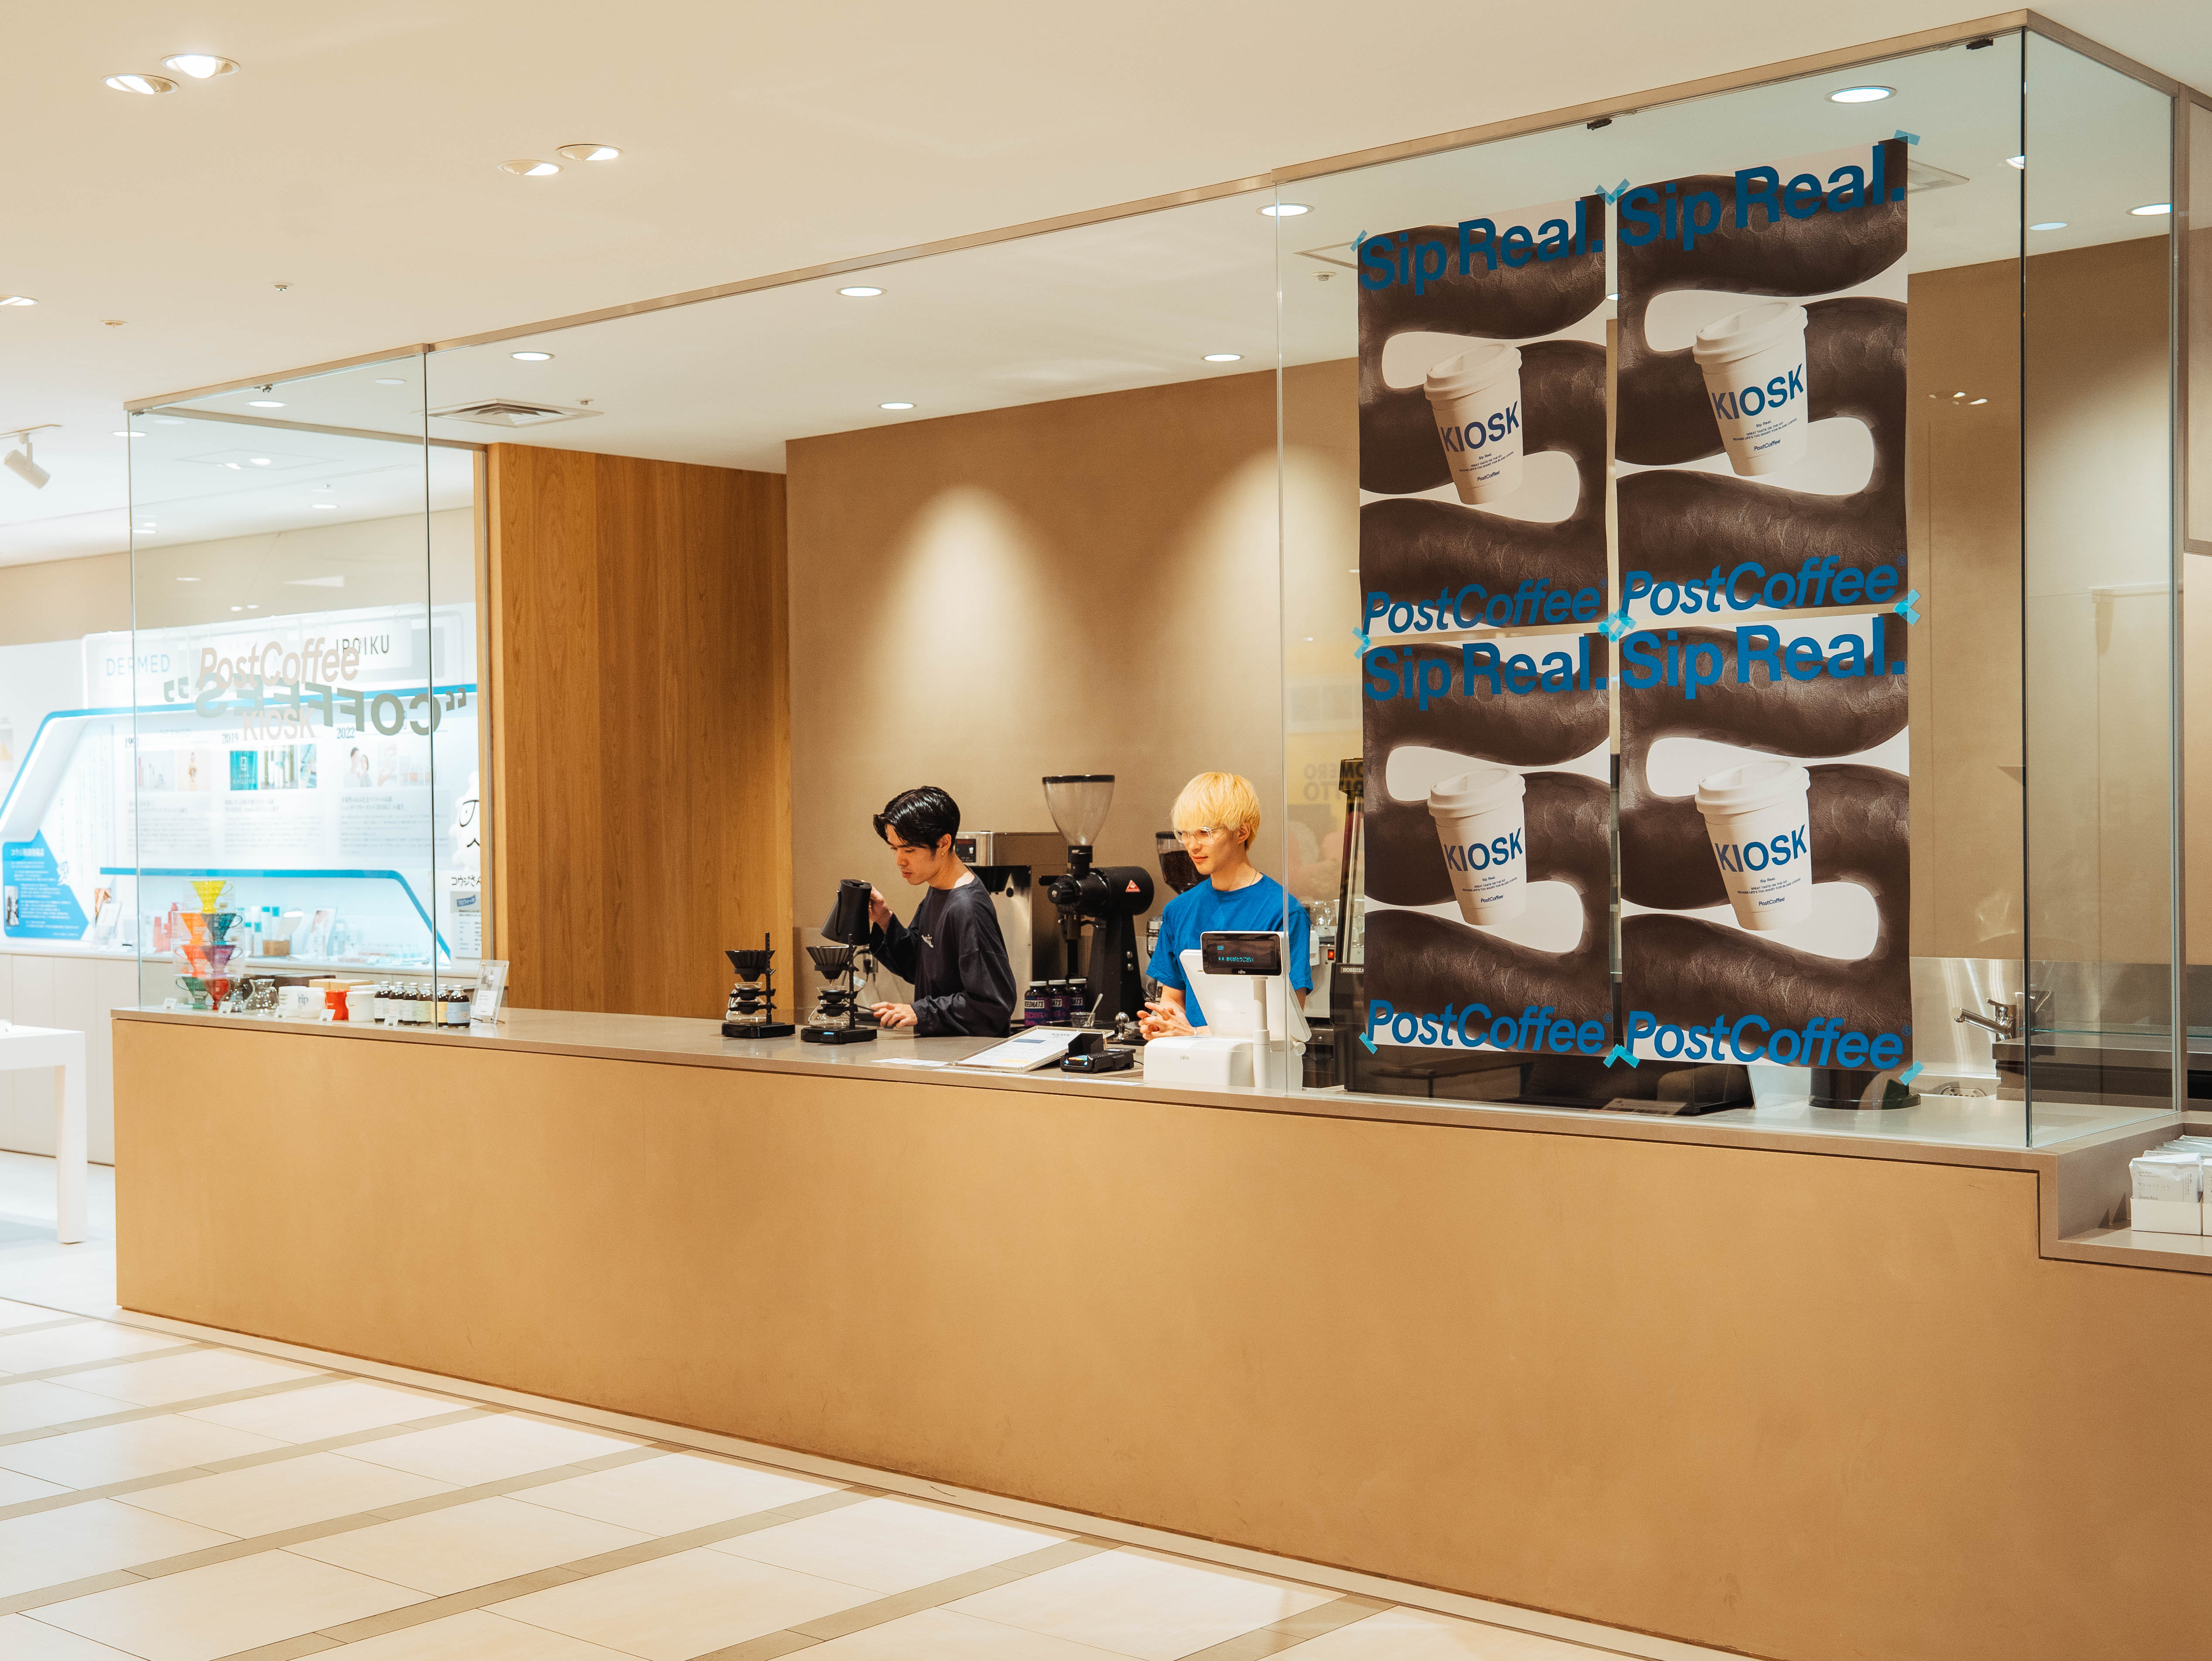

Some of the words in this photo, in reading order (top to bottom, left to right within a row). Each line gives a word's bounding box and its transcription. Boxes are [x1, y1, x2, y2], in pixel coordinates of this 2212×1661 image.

[1619, 183, 1721, 251] Sip
[1735, 144, 1905, 229] Real.
[1360, 232, 1447, 295] Sip
[1458, 200, 1603, 275] Real.
[1712, 363, 1804, 420] KIOSK
[1441, 400, 1519, 452] KIOSK
[1754, 439, 1781, 451] PostCoffee
[1477, 471, 1500, 481] PostCoffee
[198, 637, 359, 691] PostCoffee
[1364, 647, 1451, 711] Sip
[1462, 636, 1607, 696] Real.
[1622, 630, 1723, 699] Sip
[1736, 617, 1905, 684] Real.
[222, 733, 239, 744] 2019
[242, 707, 316, 741] KIOSK
[337, 727, 355, 739] 2022
[1444, 827, 1523, 872] KIOSK
[1715, 824, 1807, 872] KIOSK
[1758, 897, 1785, 906] PostCoffee
